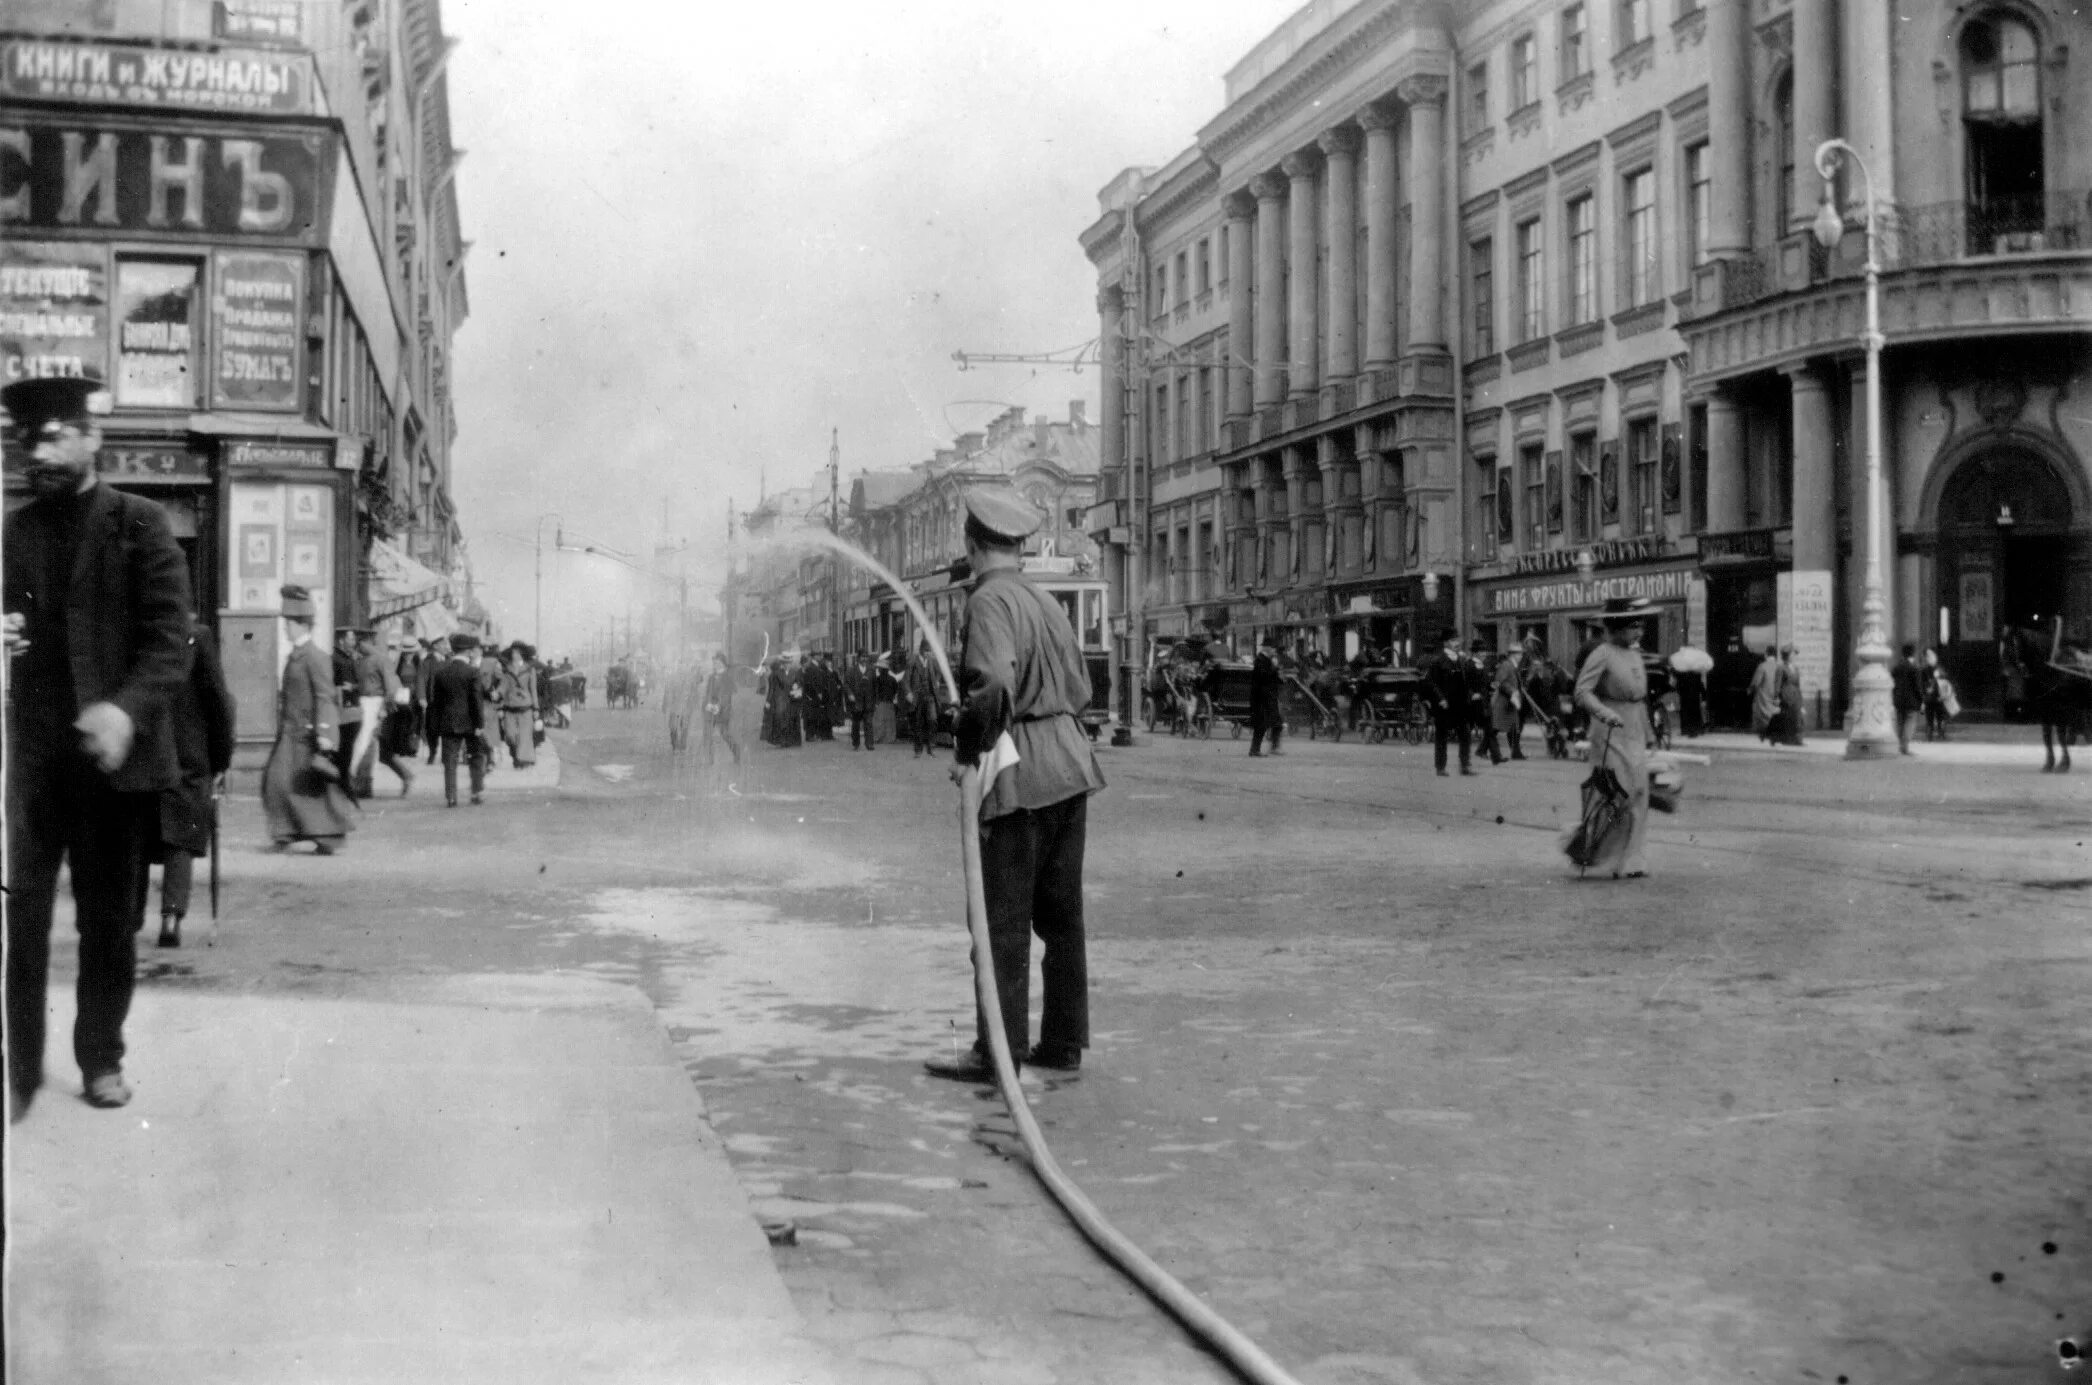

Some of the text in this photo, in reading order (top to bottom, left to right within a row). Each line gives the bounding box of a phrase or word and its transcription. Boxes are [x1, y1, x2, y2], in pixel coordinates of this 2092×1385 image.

[16, 47, 289, 94] КНИГИ и ЖУРНАЛЫ
[1495, 587, 1527, 611] ВИНА
[1530, 582, 1584, 608] ФРУКТЫ
